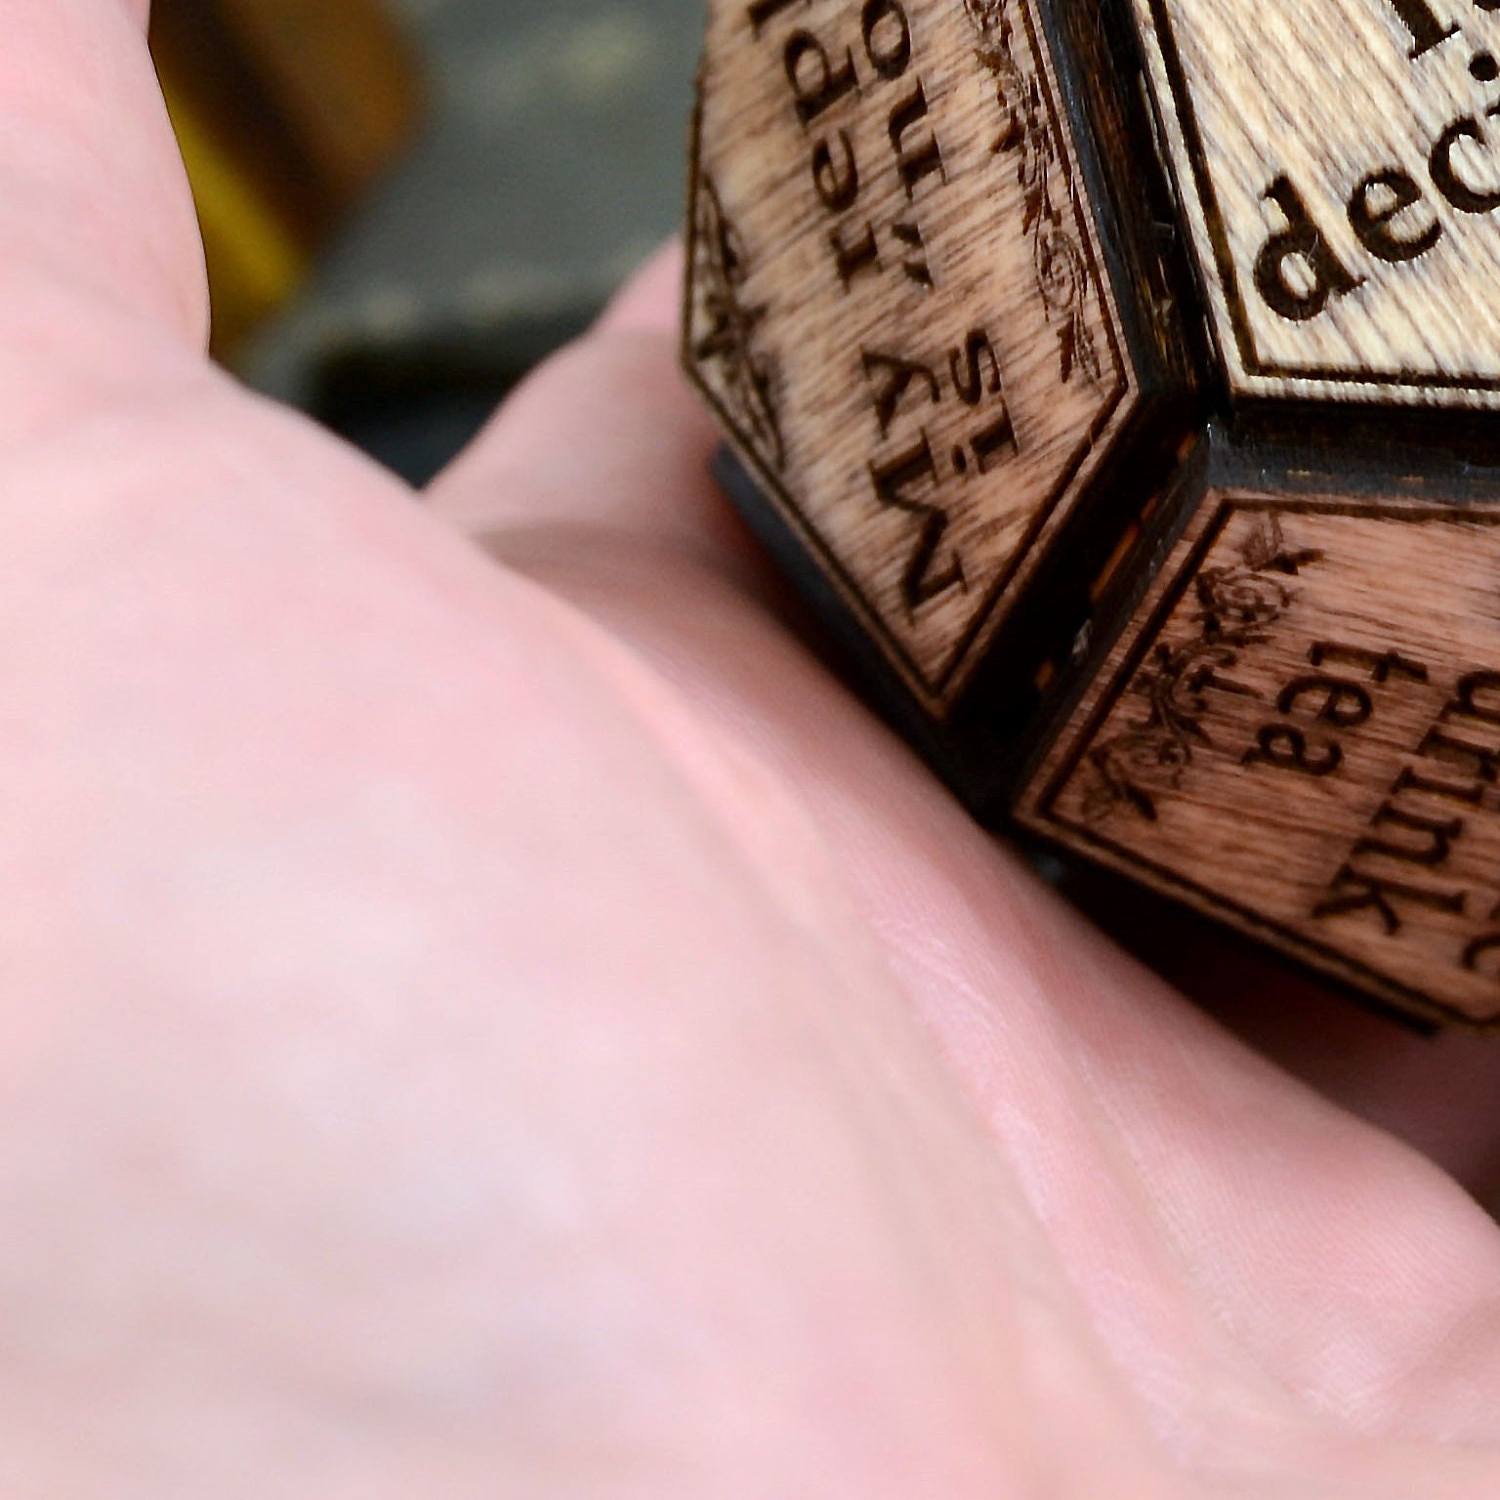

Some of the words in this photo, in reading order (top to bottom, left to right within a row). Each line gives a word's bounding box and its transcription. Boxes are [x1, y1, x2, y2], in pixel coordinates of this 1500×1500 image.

[949, 327, 1020, 476] is
[858, 342, 967, 625] My
[1240, 639, 1430, 777] tea
